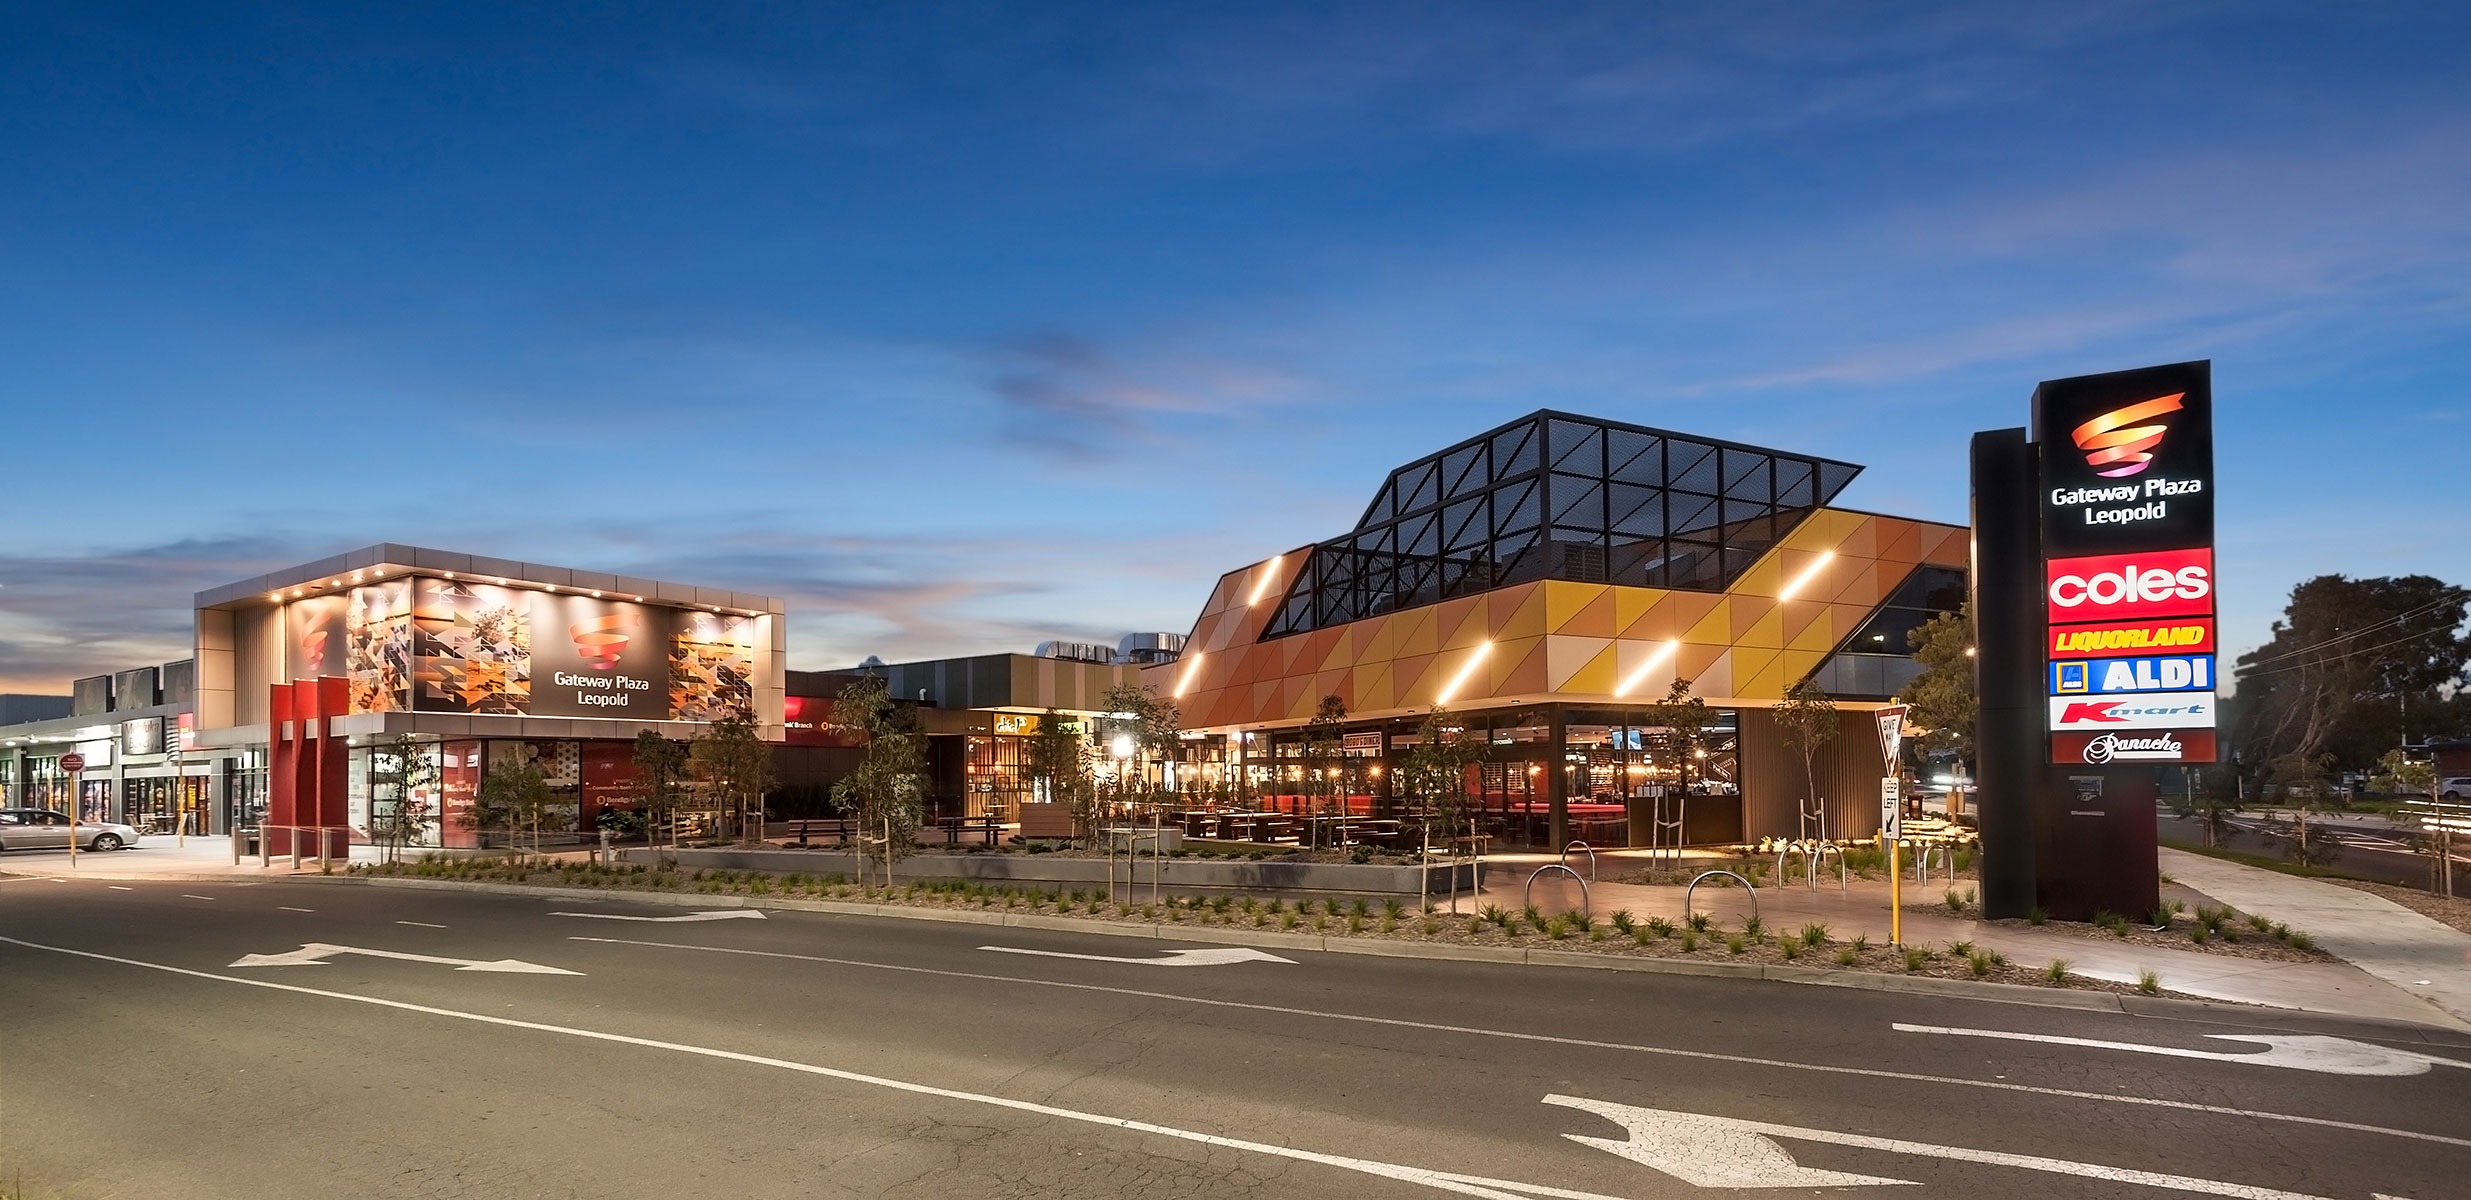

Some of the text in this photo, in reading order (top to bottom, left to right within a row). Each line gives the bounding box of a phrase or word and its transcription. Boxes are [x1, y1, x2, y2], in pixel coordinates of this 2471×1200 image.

[2052, 478, 2202, 505] Gateway Plaza
[2085, 501, 2166, 525] Leopold
[2050, 565, 2209, 607] coles
[2055, 626, 2205, 652] LIQUORLAND
[554, 671, 649, 690] Gateway Plaza
[2102, 658, 2208, 690] ALDI
[577, 690, 629, 708] Leopold
[2059, 701, 2206, 724] Kmart
[1883, 718, 1896, 731] GIVE
[1884, 782, 1897, 793] KEEP
[1884, 798, 1897, 809] LEFT
